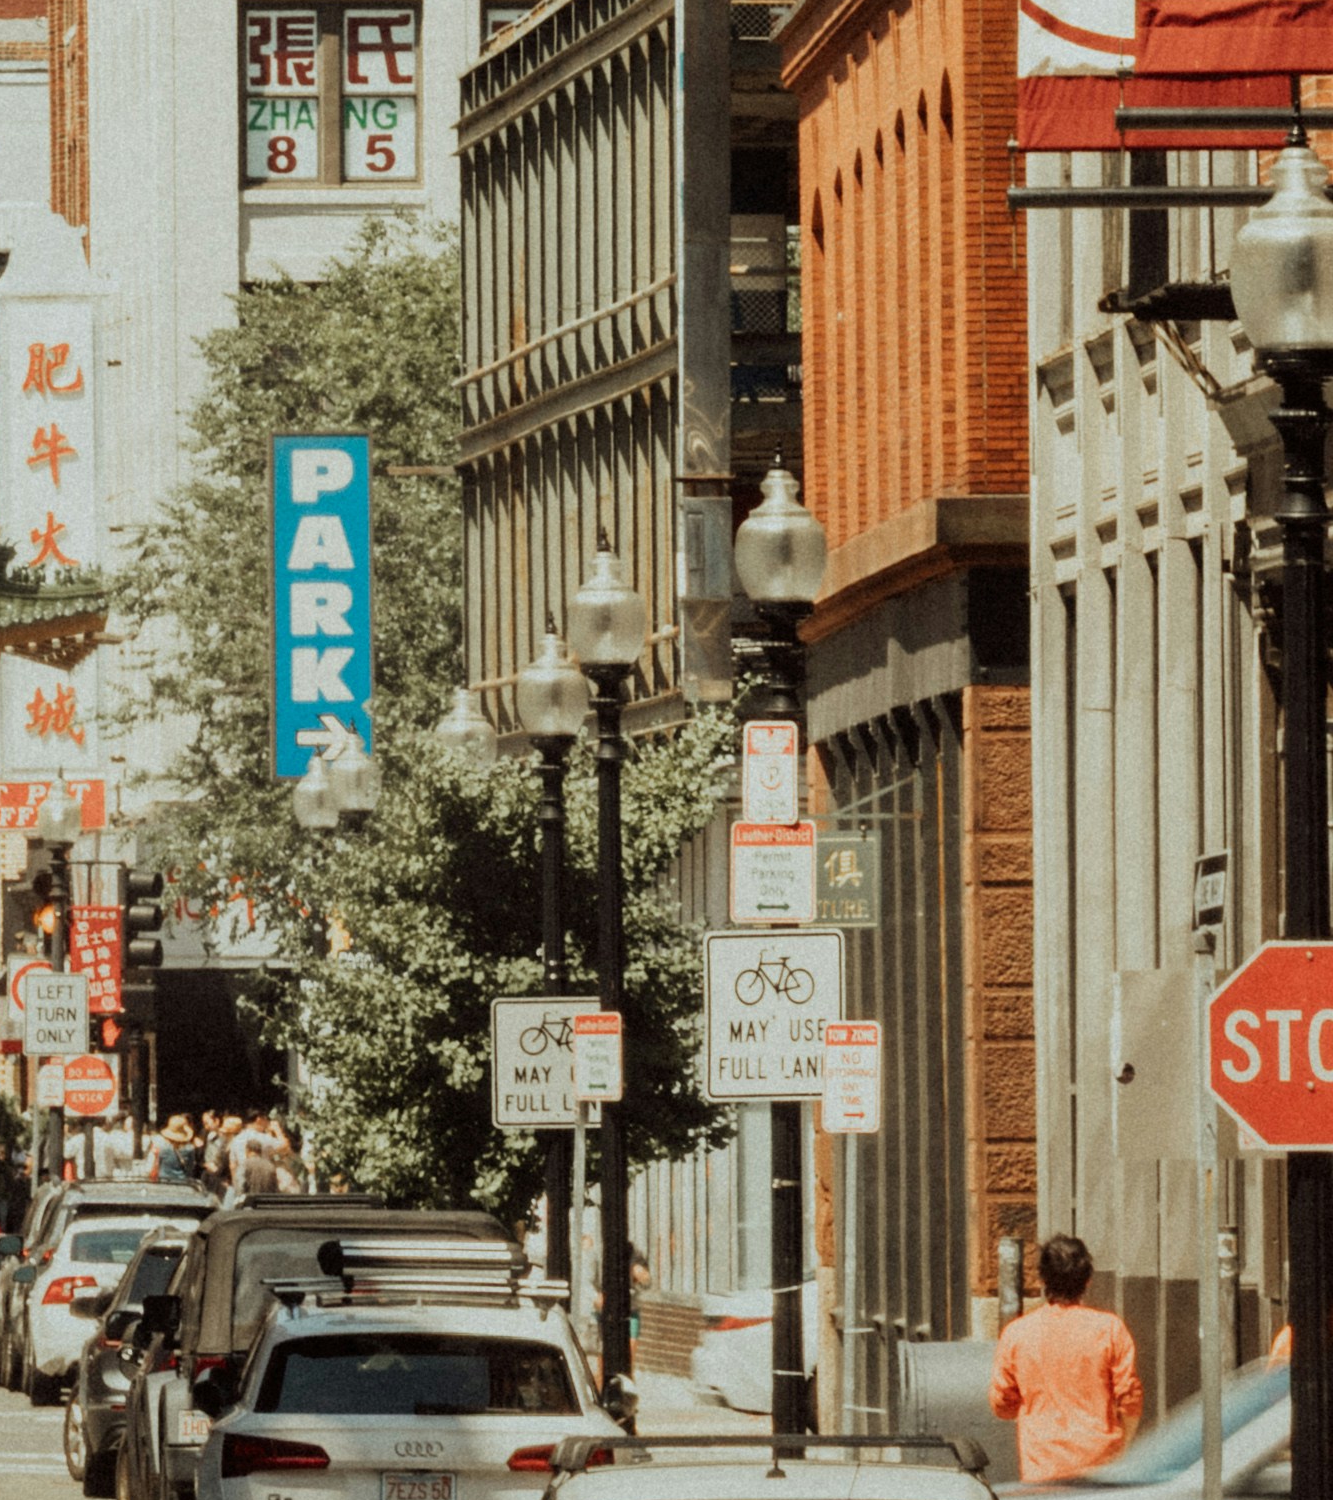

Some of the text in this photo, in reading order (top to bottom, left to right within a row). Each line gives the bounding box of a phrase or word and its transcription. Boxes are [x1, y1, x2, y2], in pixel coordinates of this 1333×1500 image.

[287, 449, 355, 702] PARK
[27, 783, 91, 808] PT
[38, 985, 74, 1000] LEFT
[37, 1008, 77, 1021] TURN
[36, 1030, 76, 1043] ONLY
[730, 1020, 769, 1043] MAY
[515, 1066, 551, 1084] MAY
[719, 1056, 767, 1079] FULL
[505, 1094, 550, 1112] FULL
